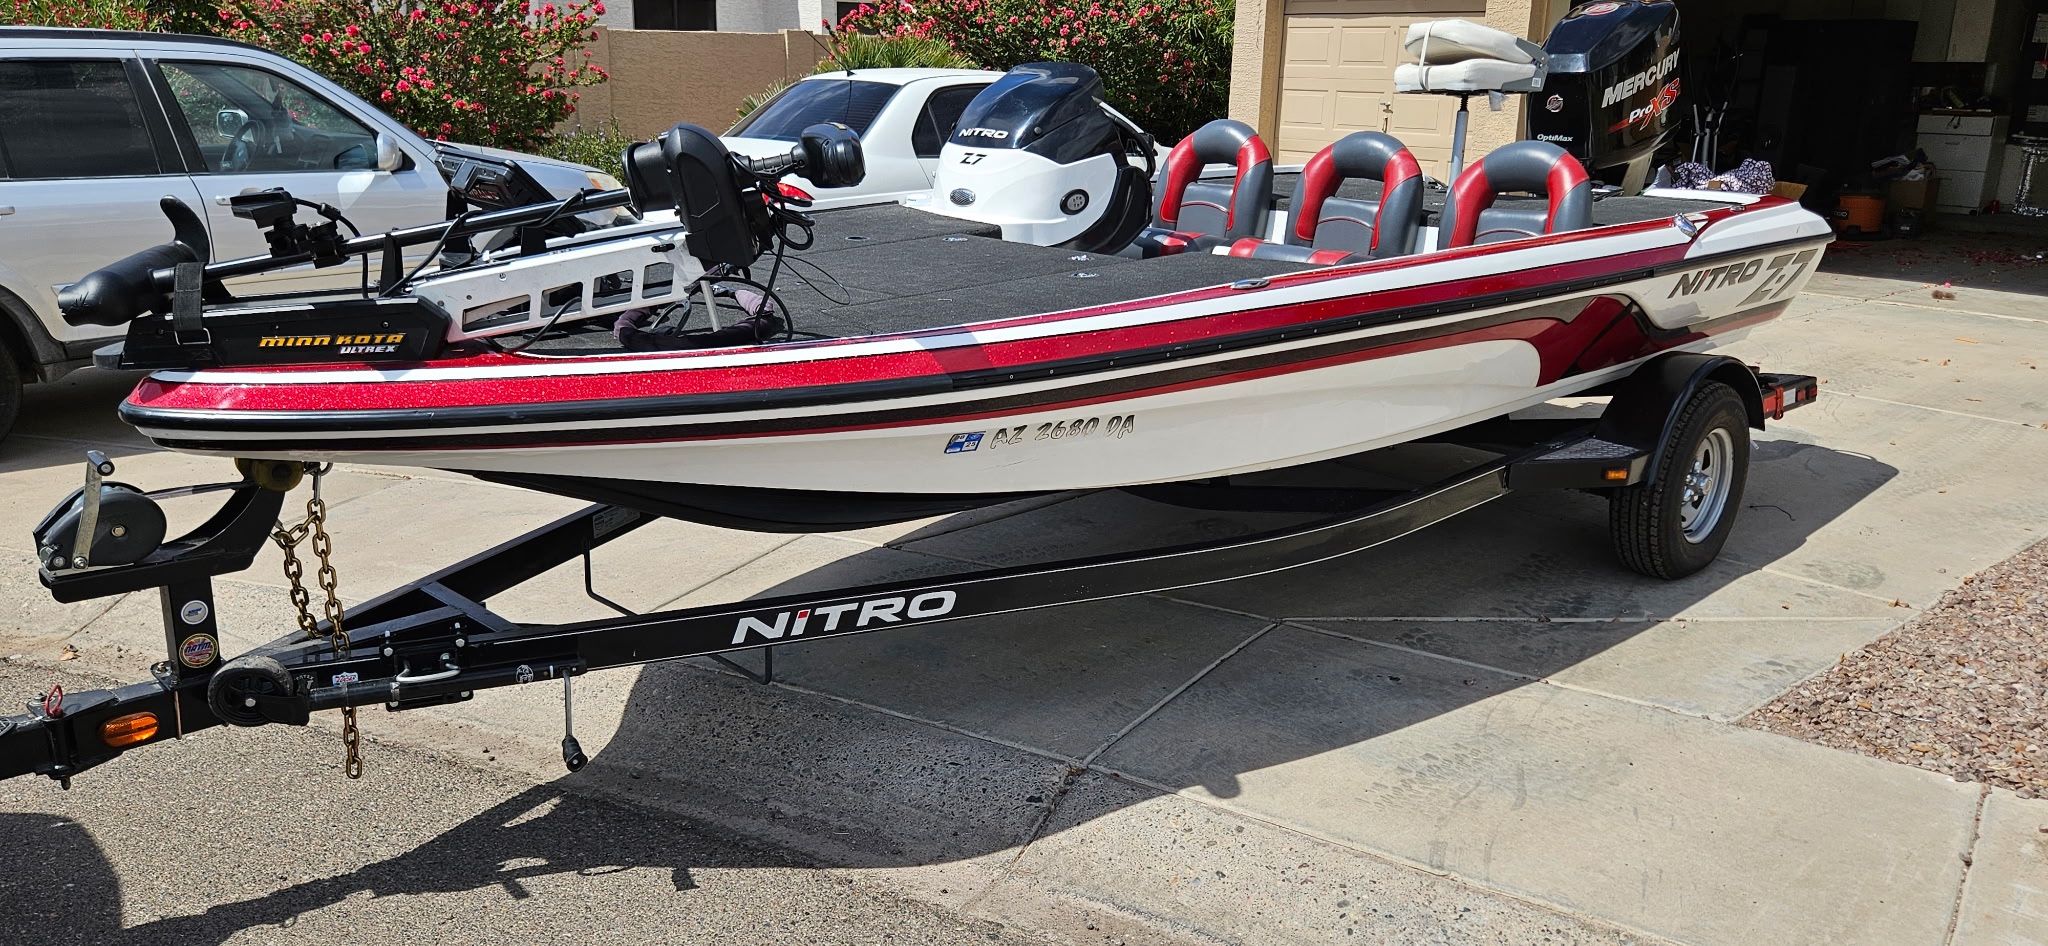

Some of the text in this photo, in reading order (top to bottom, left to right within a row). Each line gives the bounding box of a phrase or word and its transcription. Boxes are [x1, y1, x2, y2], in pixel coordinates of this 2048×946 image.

[1601, 47, 1680, 109] MERCURY
[958, 127, 1009, 139] NITRO
[1536, 133, 1574, 142] OptiMax
[960, 152, 988, 166] Z7
[1667, 258, 1764, 299] NITRO
[258, 333, 406, 348] MINN KOTA
[340, 344, 399, 354] ULTREX
[989, 414, 1136, 450] AZ 2680 DA
